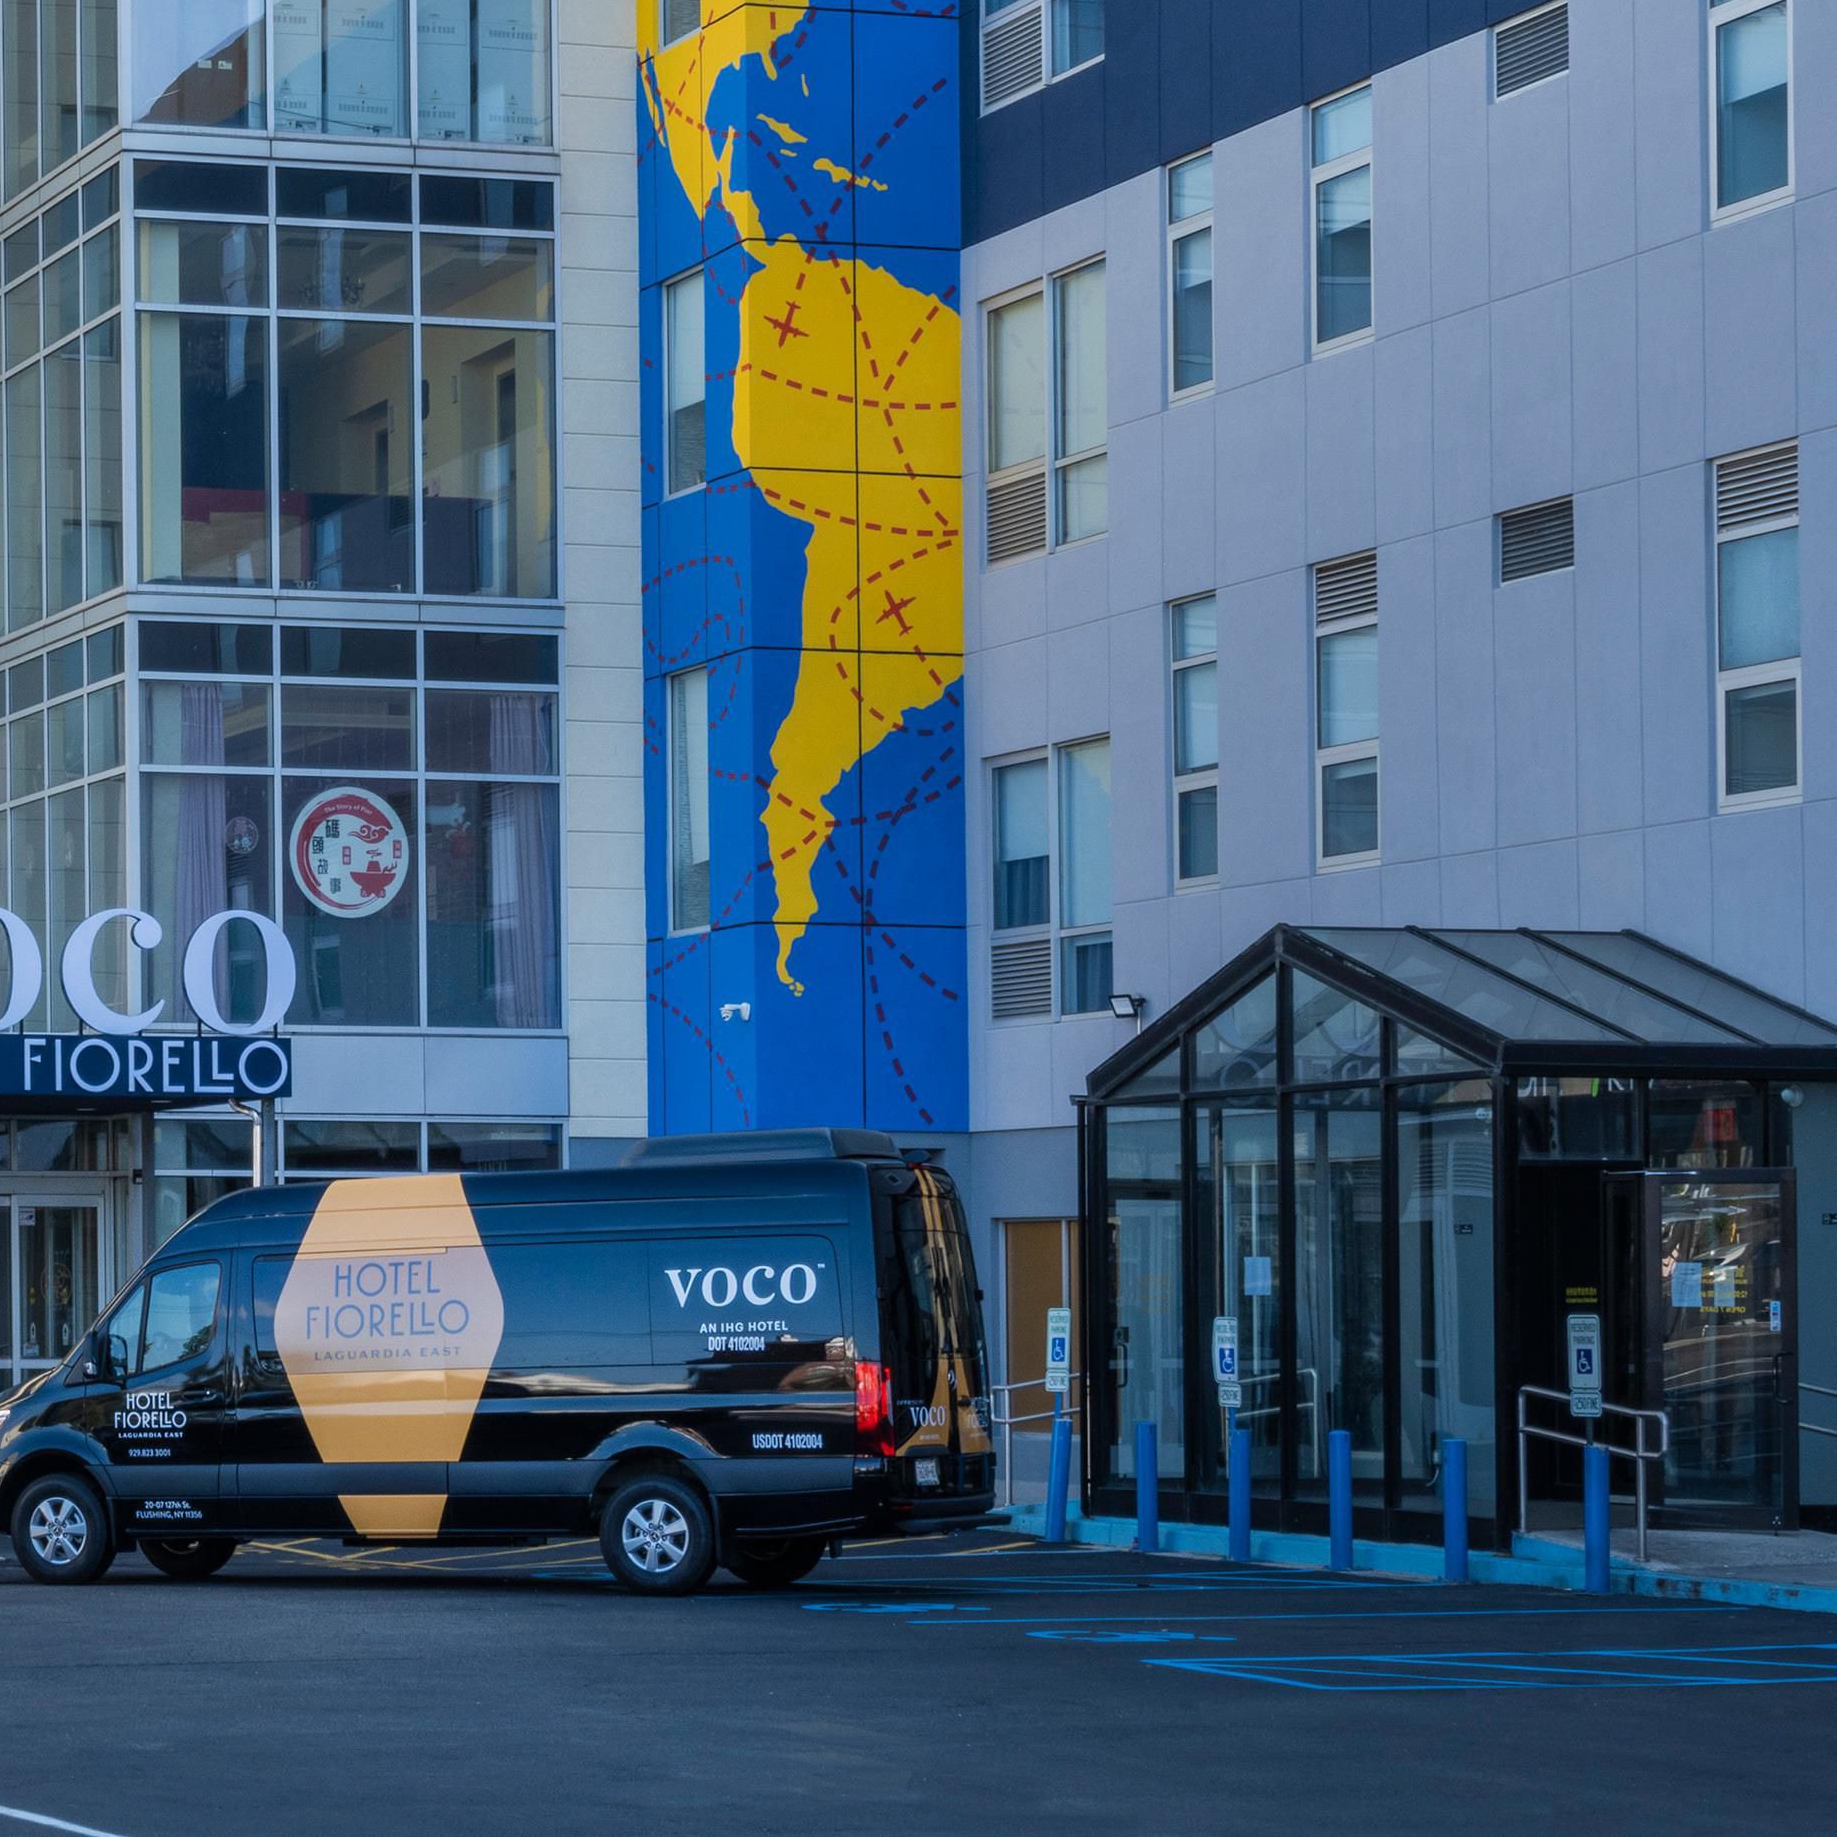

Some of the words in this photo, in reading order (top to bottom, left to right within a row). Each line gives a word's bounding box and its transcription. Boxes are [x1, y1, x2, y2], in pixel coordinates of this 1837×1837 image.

[23, 1036, 288, 1095] FIORELLO
[334, 1260, 441, 1298] HOTEL
[306, 1299, 470, 1339] FIORELLO
[699, 1322, 717, 1334] AN
[721, 1321, 744, 1333] IHG
[748, 1320, 788, 1332] HOTEL
[708, 1337, 728, 1352] DOT
[728, 1336, 765, 1352] 4102004
[314, 1348, 412, 1361] LAGUARDIA
[420, 1346, 462, 1358] EAST
[126, 1392, 174, 1410] HOTEL
[114, 1410, 187, 1429] FIORELLO
[910, 1406, 946, 1427] VOCO
[118, 1431, 162, 1439] LAGUARDIA
[164, 1431, 183, 1439] EAST
[752, 1434, 784, 1449] USDOT
[785, 1433, 823, 1449] 4102004
[154, 1448, 171, 1457] 3001
[144, 1501, 164, 1509] 20-07
[174, 1510, 184, 1519] NY
[185, 1510, 202, 1519] 11356
